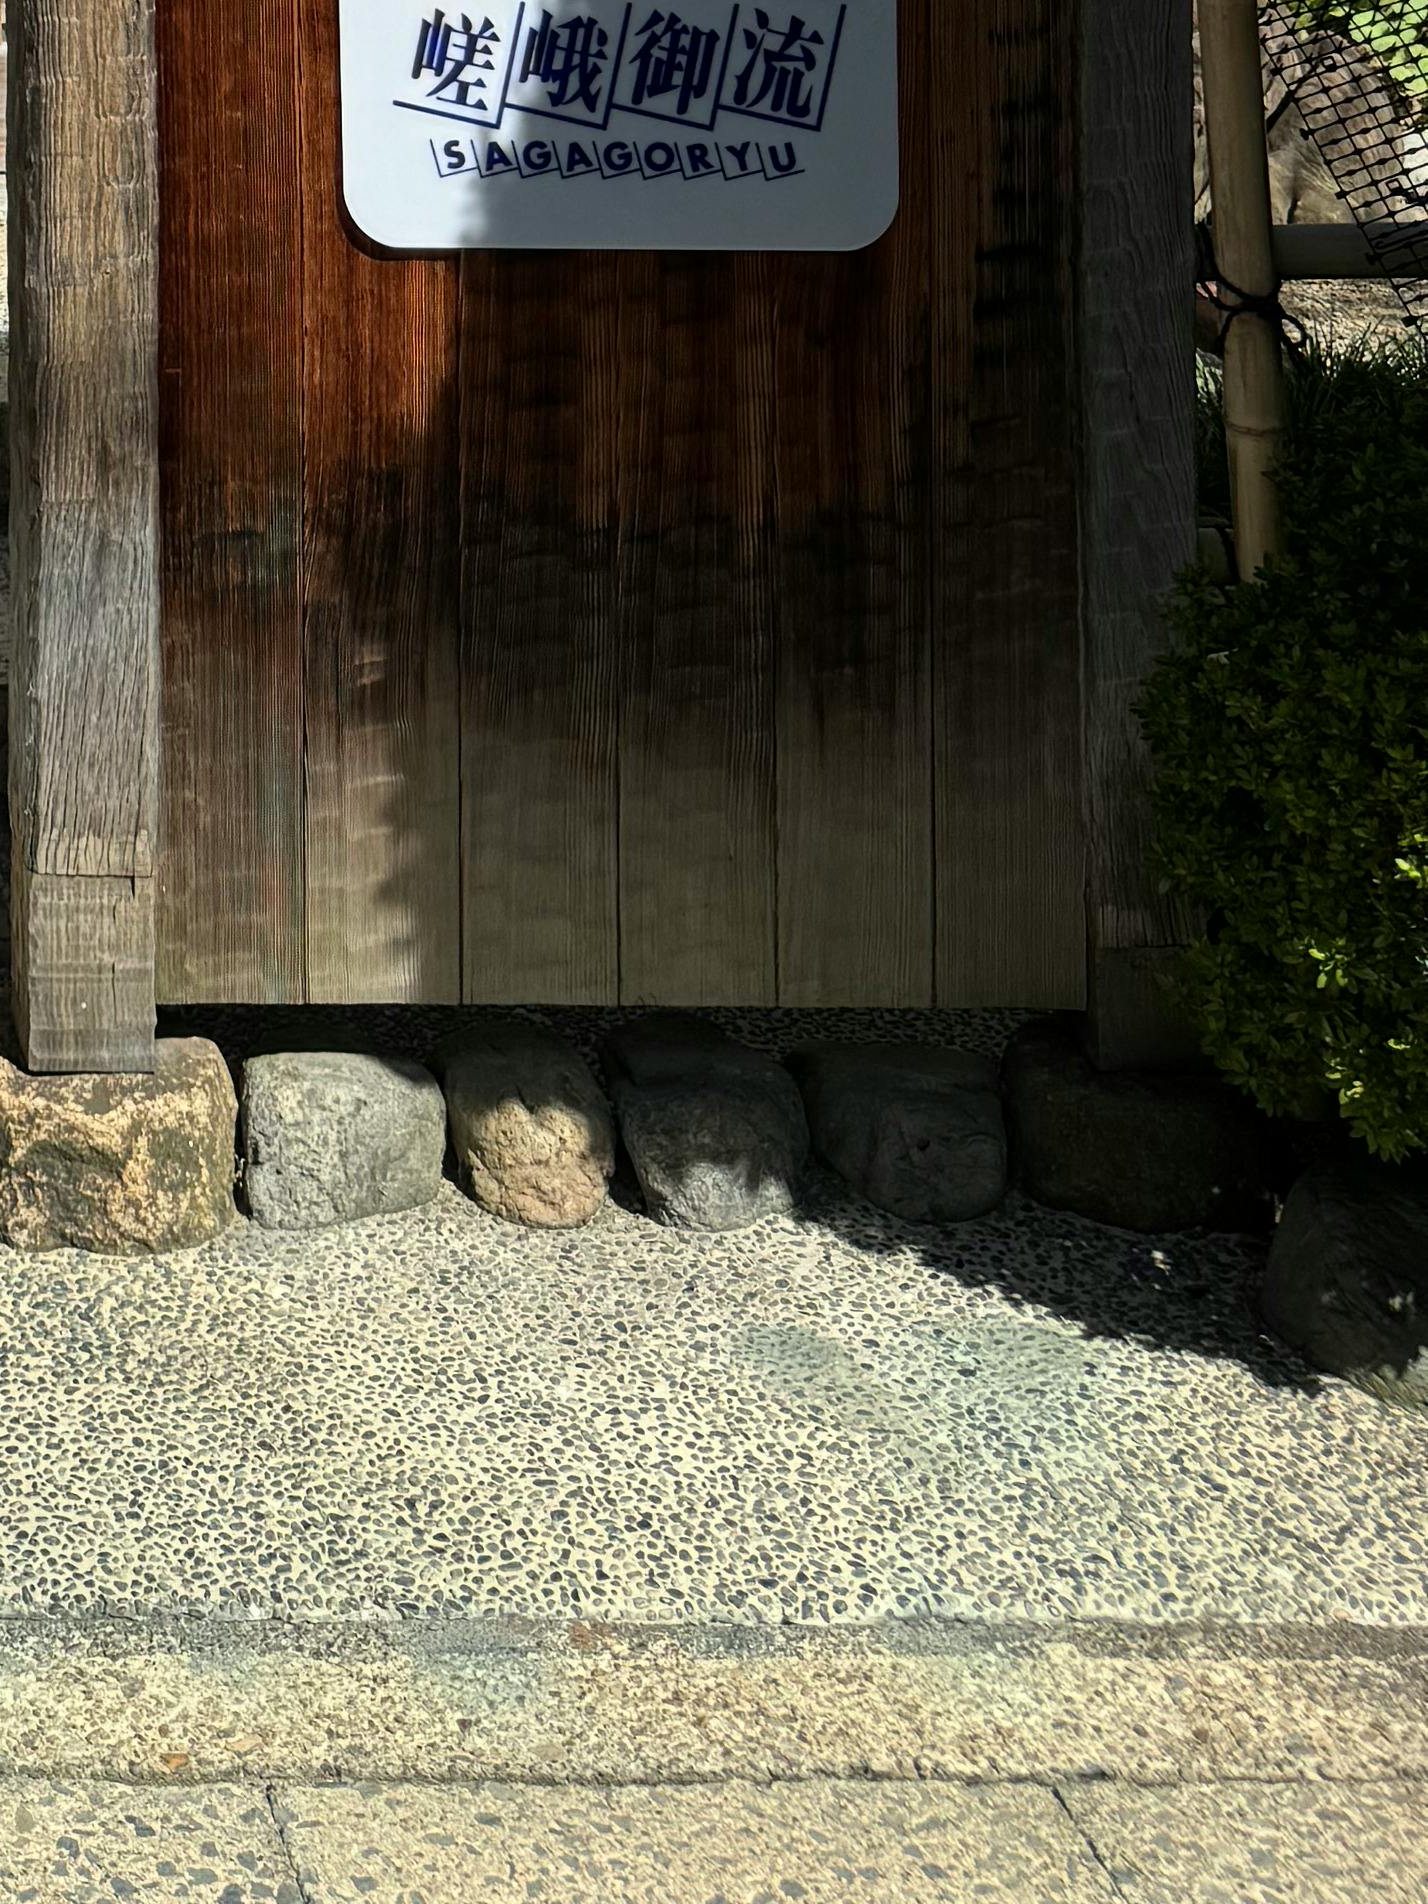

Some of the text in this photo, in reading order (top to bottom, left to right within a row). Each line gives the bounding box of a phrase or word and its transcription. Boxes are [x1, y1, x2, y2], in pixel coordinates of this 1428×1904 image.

[411, 7, 825, 119] 嵯峨御流
[443, 139, 798, 173] SAGAGORYU
